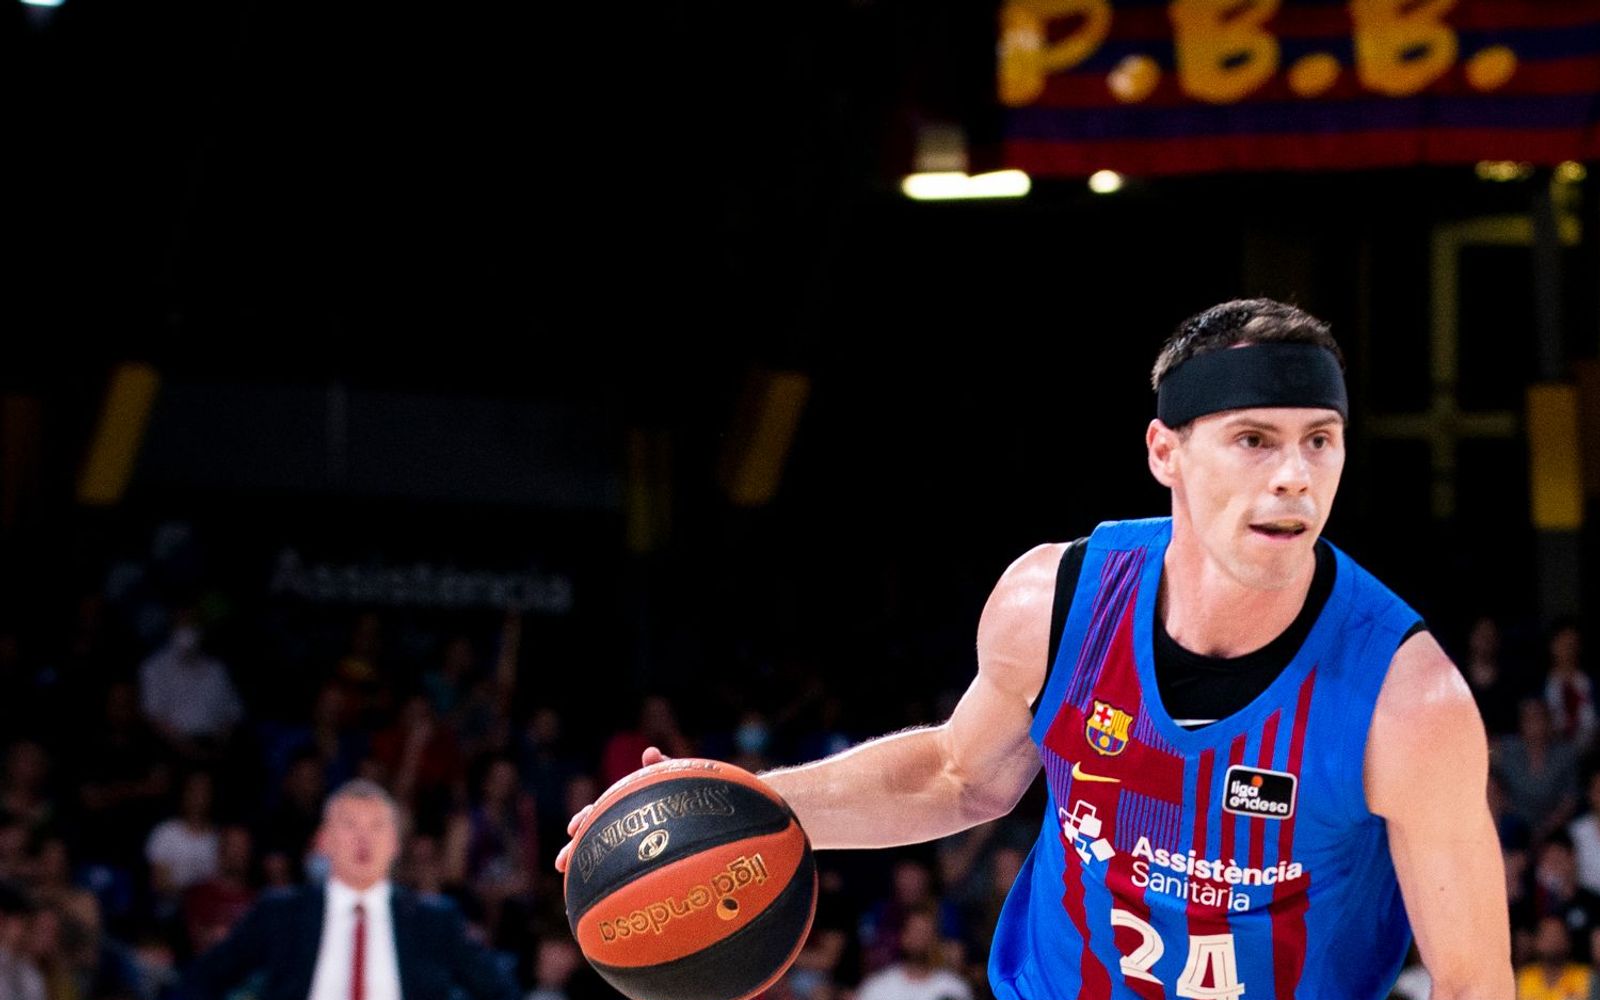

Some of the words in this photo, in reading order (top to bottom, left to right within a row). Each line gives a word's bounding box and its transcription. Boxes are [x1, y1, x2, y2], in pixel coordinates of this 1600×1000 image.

[1229, 796, 1289, 814] endesa
[1230, 780, 1259, 798] liga
[576, 784, 736, 884] SPALDING
[1131, 836, 1303, 887] Assistència
[1131, 861, 1250, 912] Sanitària
